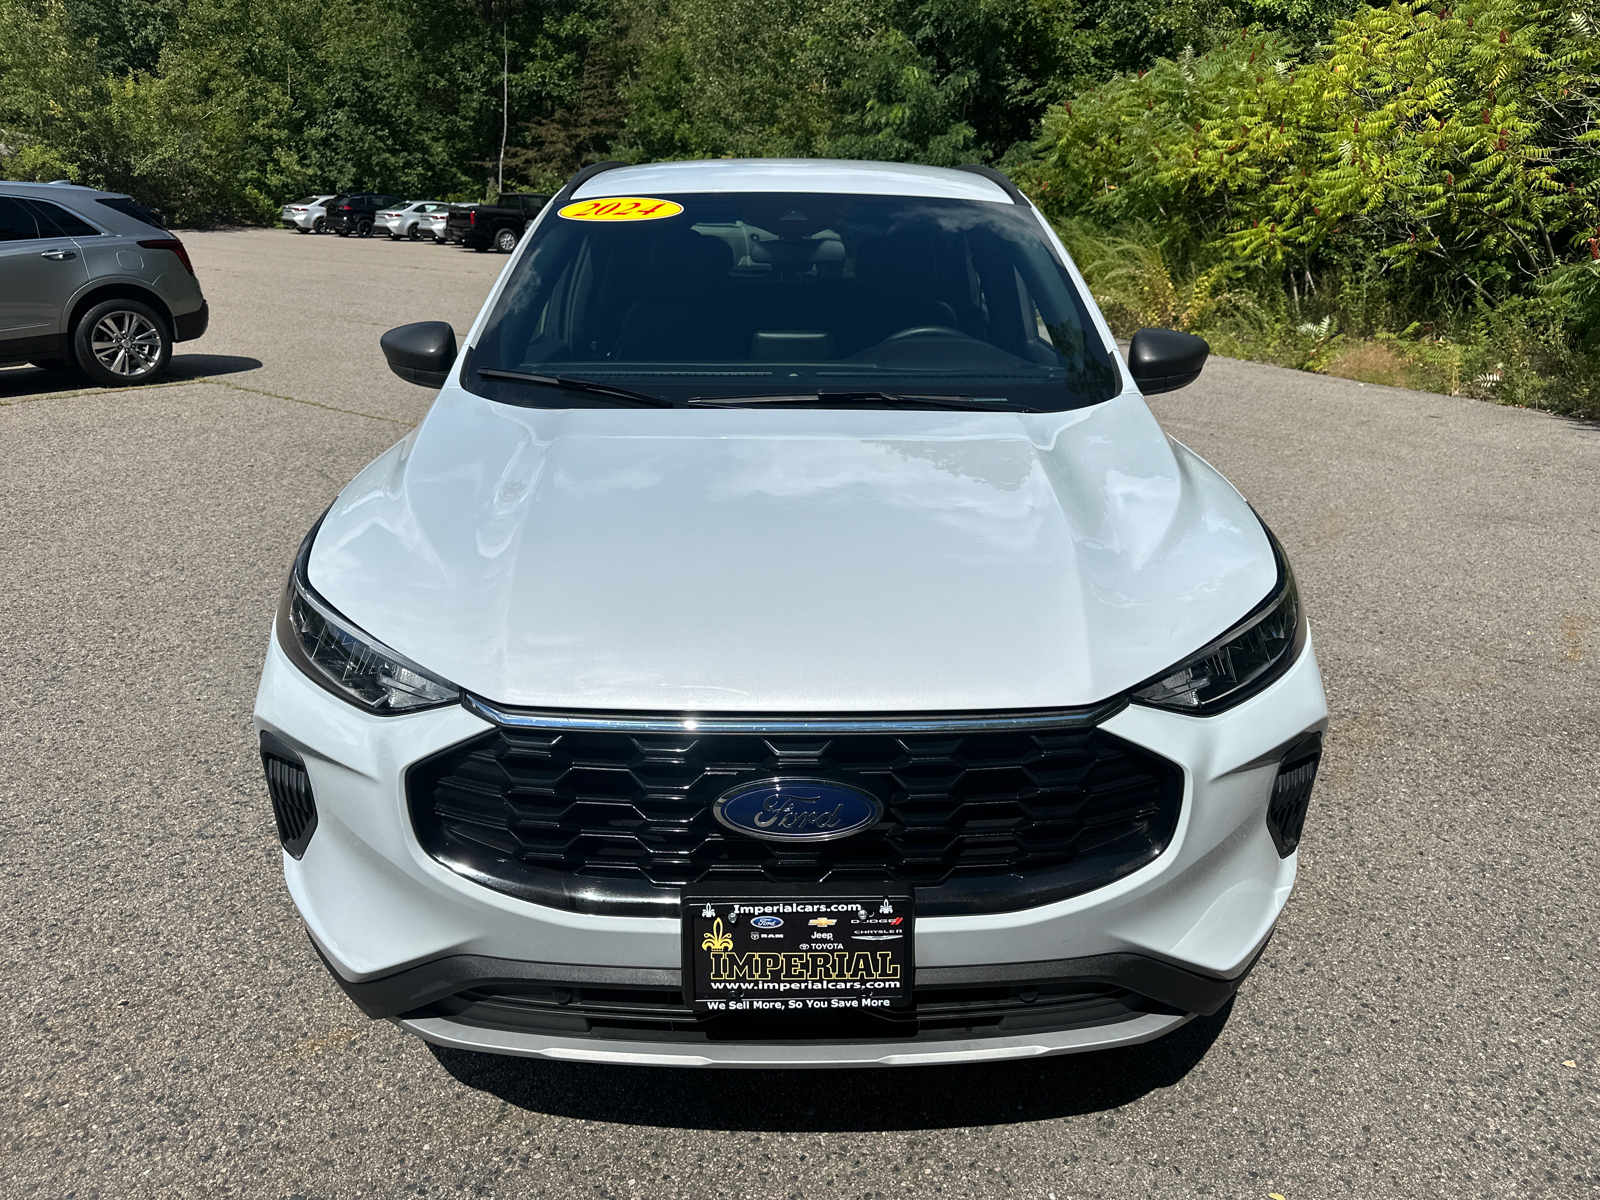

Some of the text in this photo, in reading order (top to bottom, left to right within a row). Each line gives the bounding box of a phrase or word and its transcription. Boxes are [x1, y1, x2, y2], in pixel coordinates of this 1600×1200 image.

[571, 202, 667, 217] 2024
[754, 794, 844, 829] Ford
[733, 903, 861, 915] Imperialcars.com
[811, 931, 833, 941] Jeep
[710, 951, 900, 980] IMPERIAL
[710, 980, 900, 991] www.imperialcars.com
[707, 998, 890, 1010] We Sell More, So You Save More
